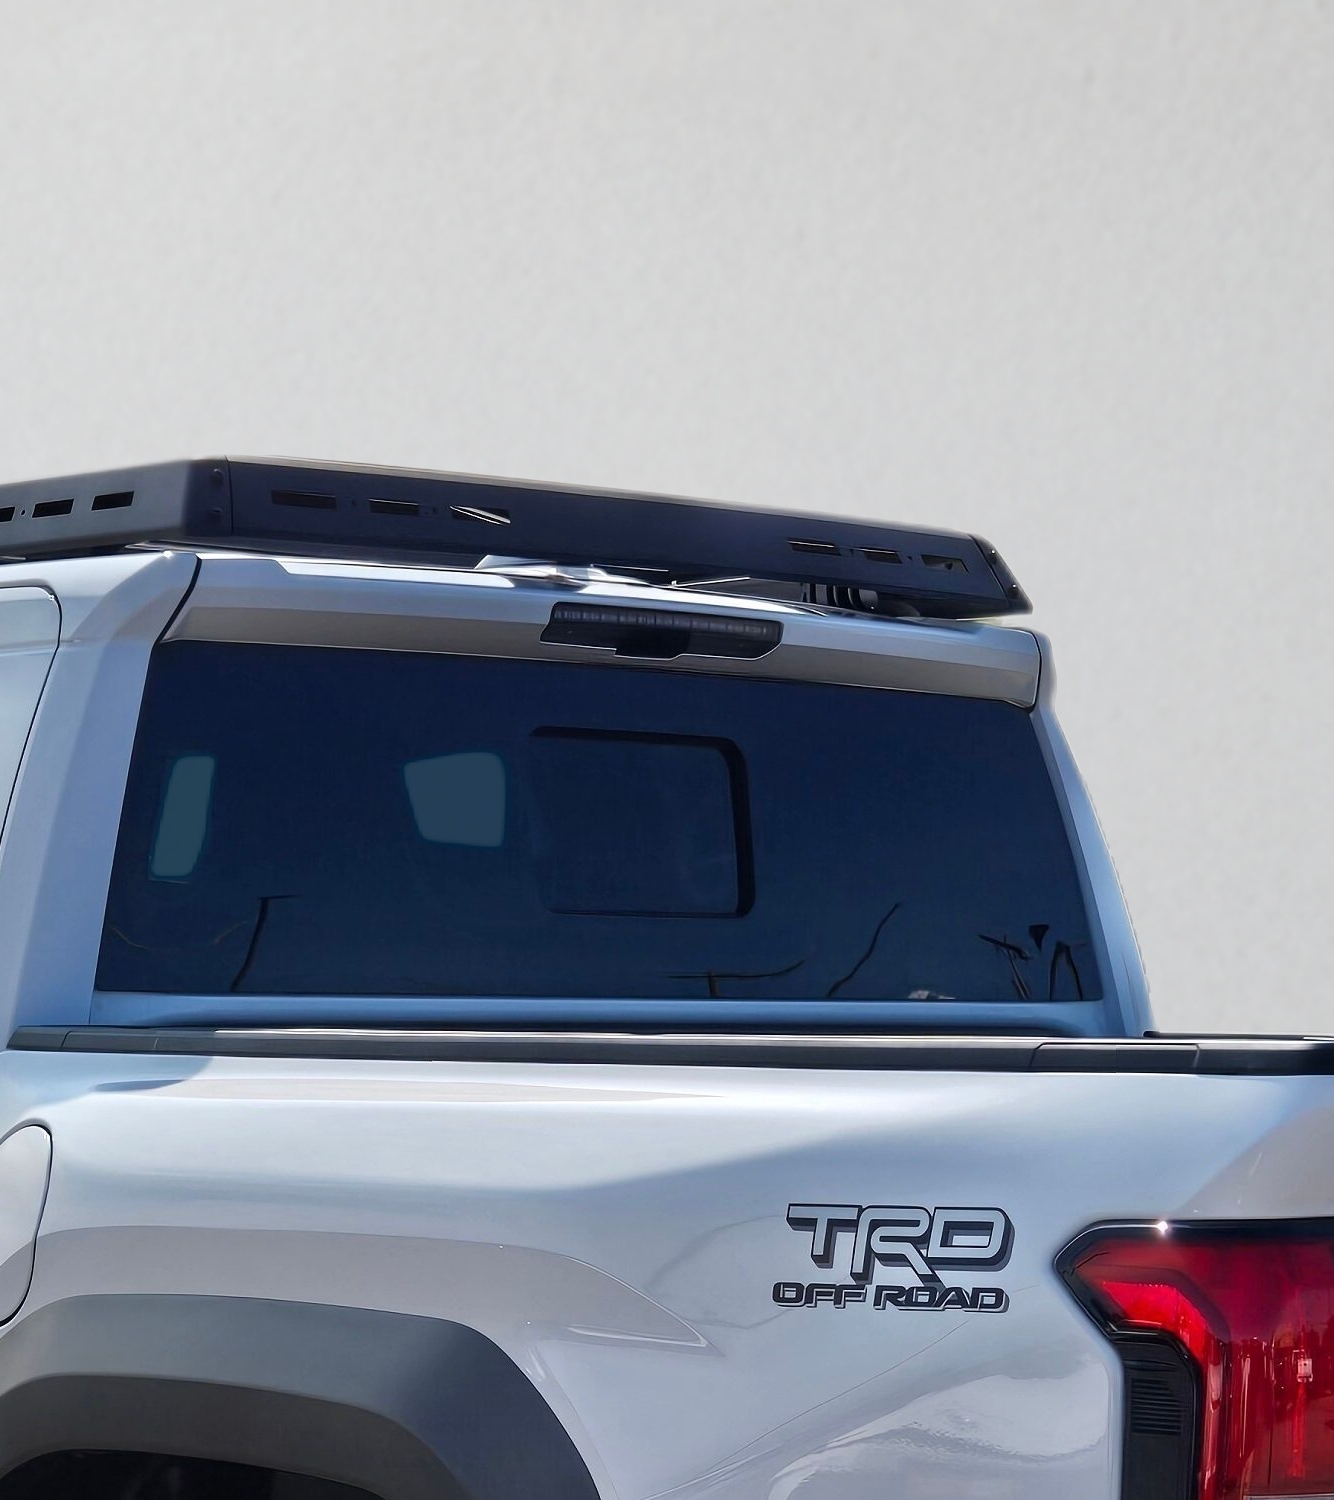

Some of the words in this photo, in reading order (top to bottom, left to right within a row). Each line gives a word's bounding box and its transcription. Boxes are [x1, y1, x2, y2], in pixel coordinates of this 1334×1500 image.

[786, 1203, 1015, 1287] TRD
[772, 1282, 867, 1308] OFF
[873, 1284, 1010, 1313] ROAD
